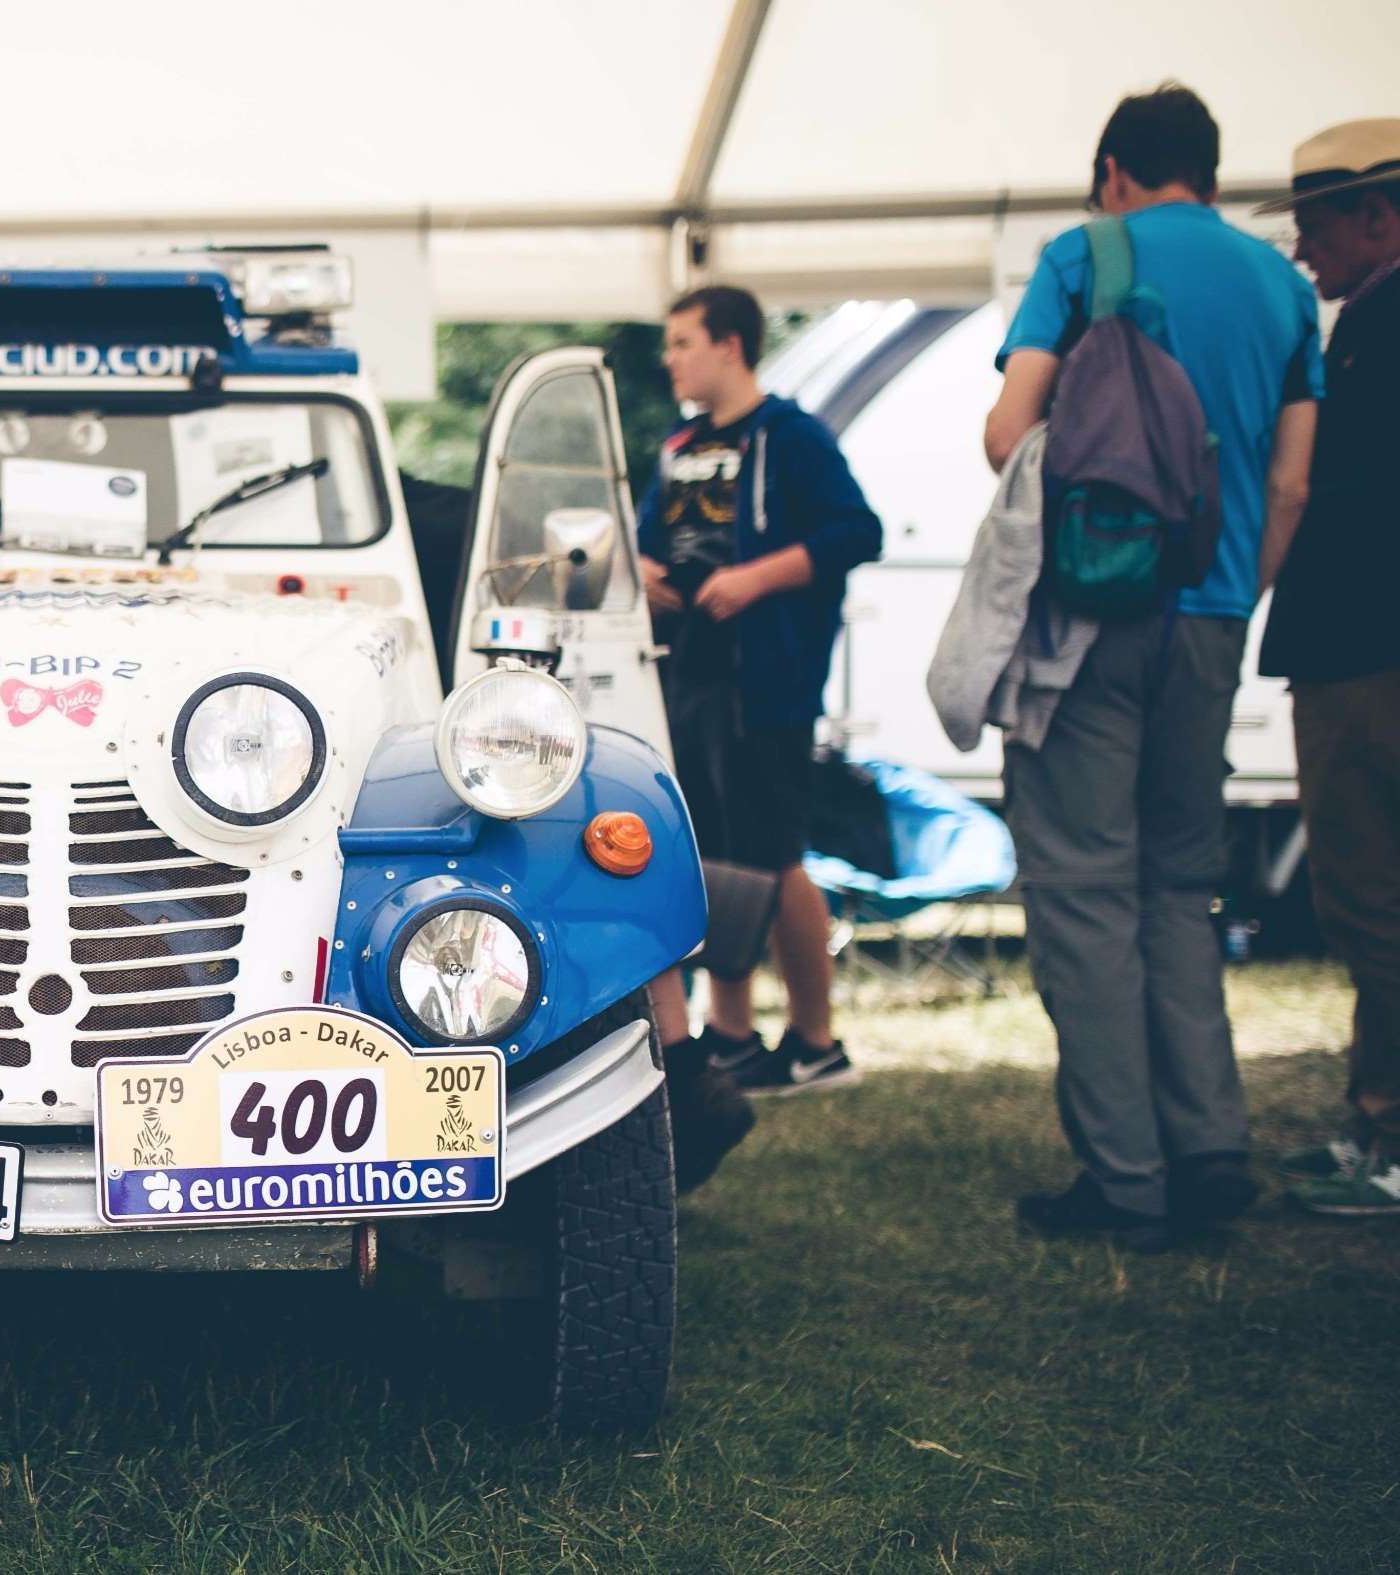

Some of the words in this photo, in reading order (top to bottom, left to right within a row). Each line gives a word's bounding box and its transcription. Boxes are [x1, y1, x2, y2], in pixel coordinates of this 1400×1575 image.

[211, 1026, 291, 1069] Lisboa
[317, 1022, 389, 1063] Dakar
[121, 1077, 184, 1105] 1979
[425, 1065, 486, 1093] 2007
[230, 1077, 378, 1156] 400
[189, 1161, 467, 1209] euromilhões
